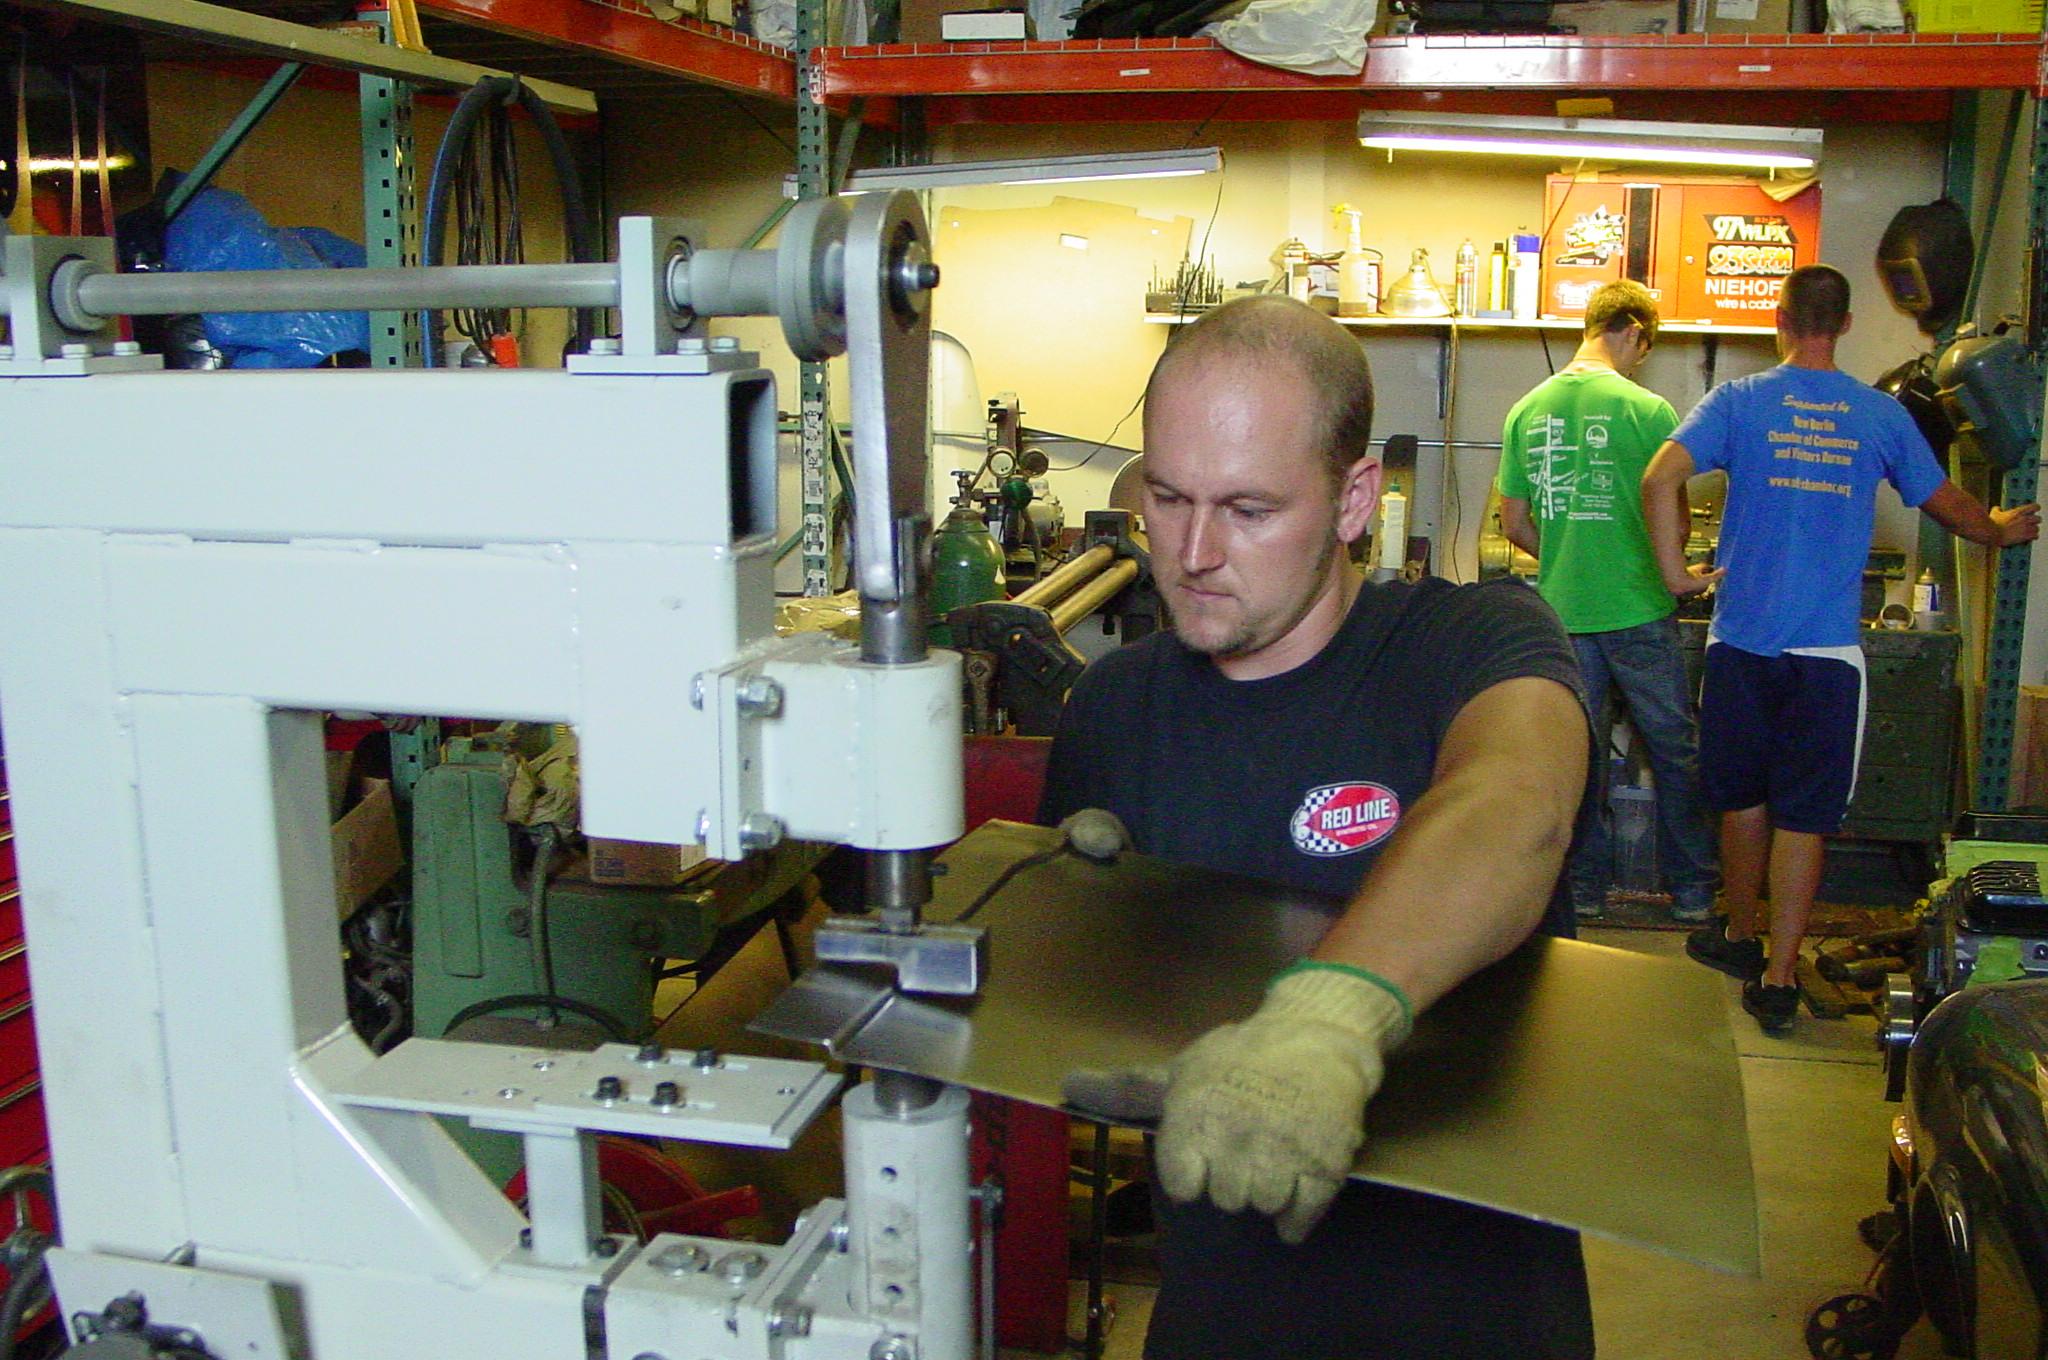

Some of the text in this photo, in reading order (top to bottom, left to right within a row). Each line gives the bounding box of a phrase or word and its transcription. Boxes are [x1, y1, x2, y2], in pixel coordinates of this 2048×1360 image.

[1704, 279, 1783, 296] NIEHOF
[1715, 298, 1739, 309] wire
[1814, 434, 1859, 450] Commerce
[1321, 798, 1391, 830] RED LINE
